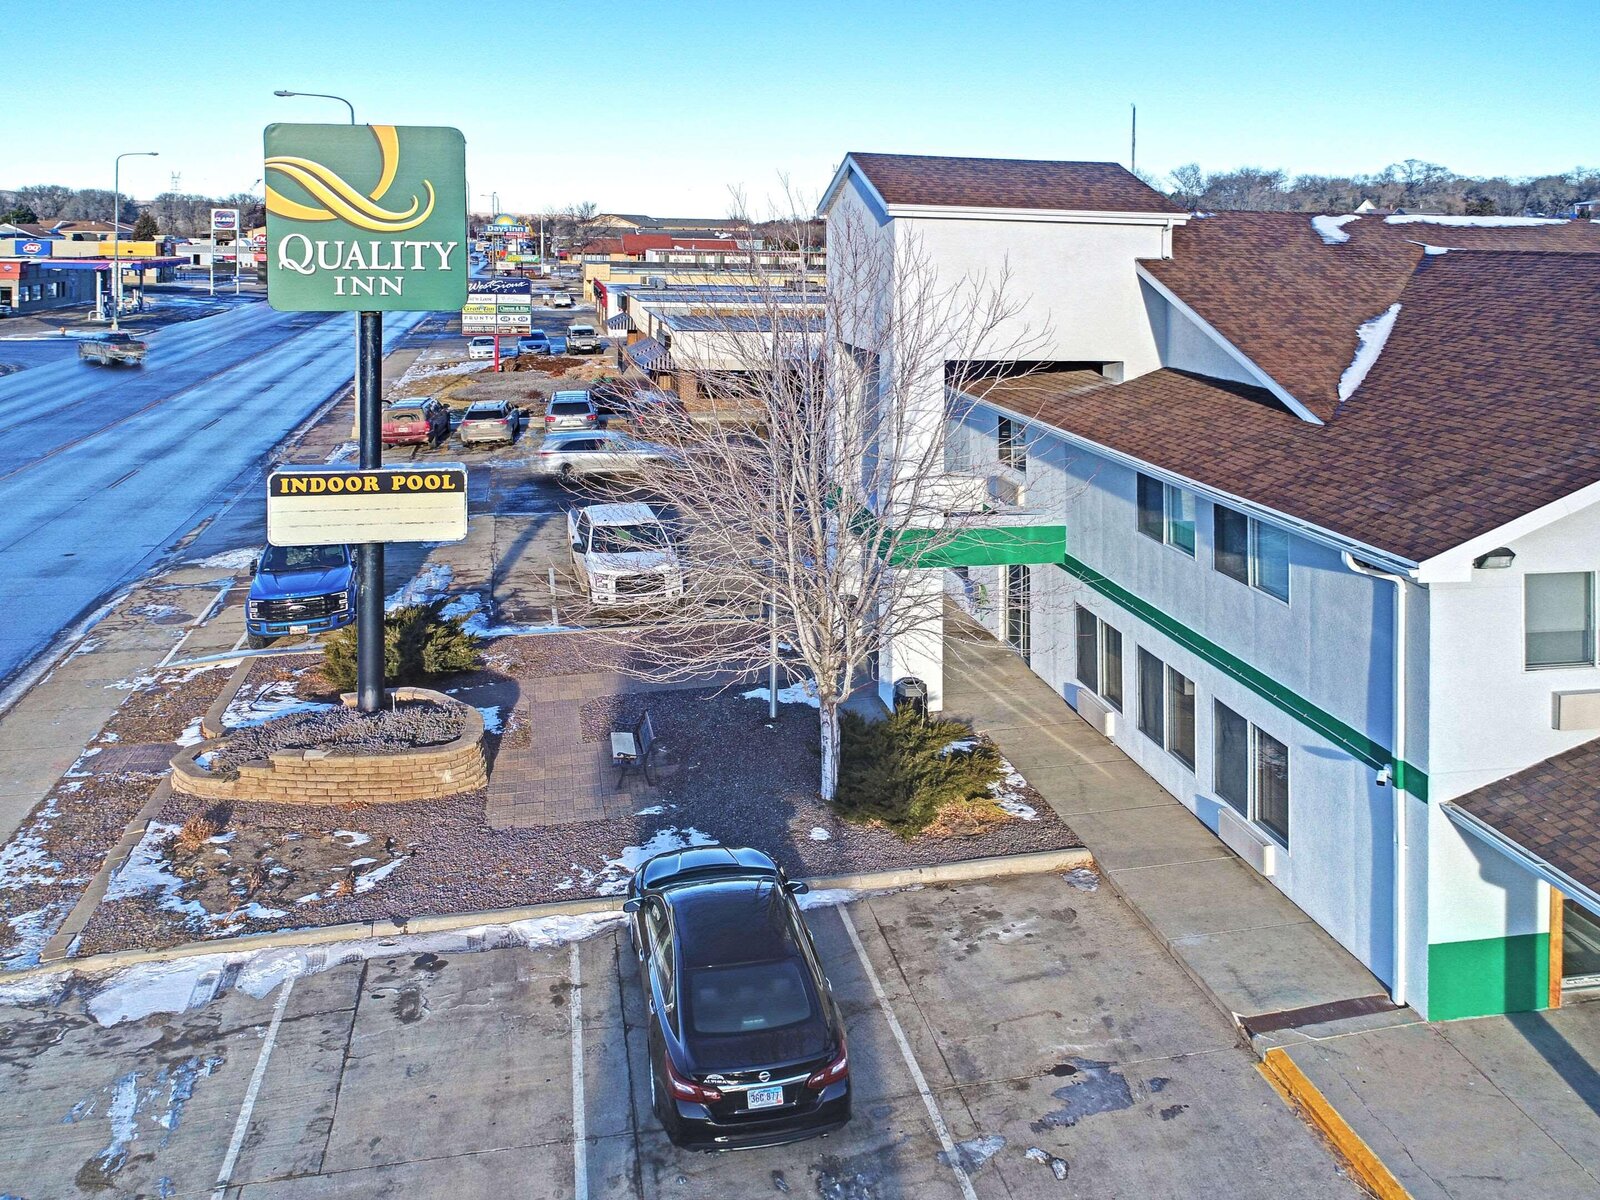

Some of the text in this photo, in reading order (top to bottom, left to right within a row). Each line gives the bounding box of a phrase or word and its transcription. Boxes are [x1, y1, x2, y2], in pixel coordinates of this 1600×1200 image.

[278, 233, 459, 275] QUALITY
[334, 276, 404, 296] INN
[468, 280, 529, 291] West Sioux
[280, 474, 456, 494] INDOOR POOL
